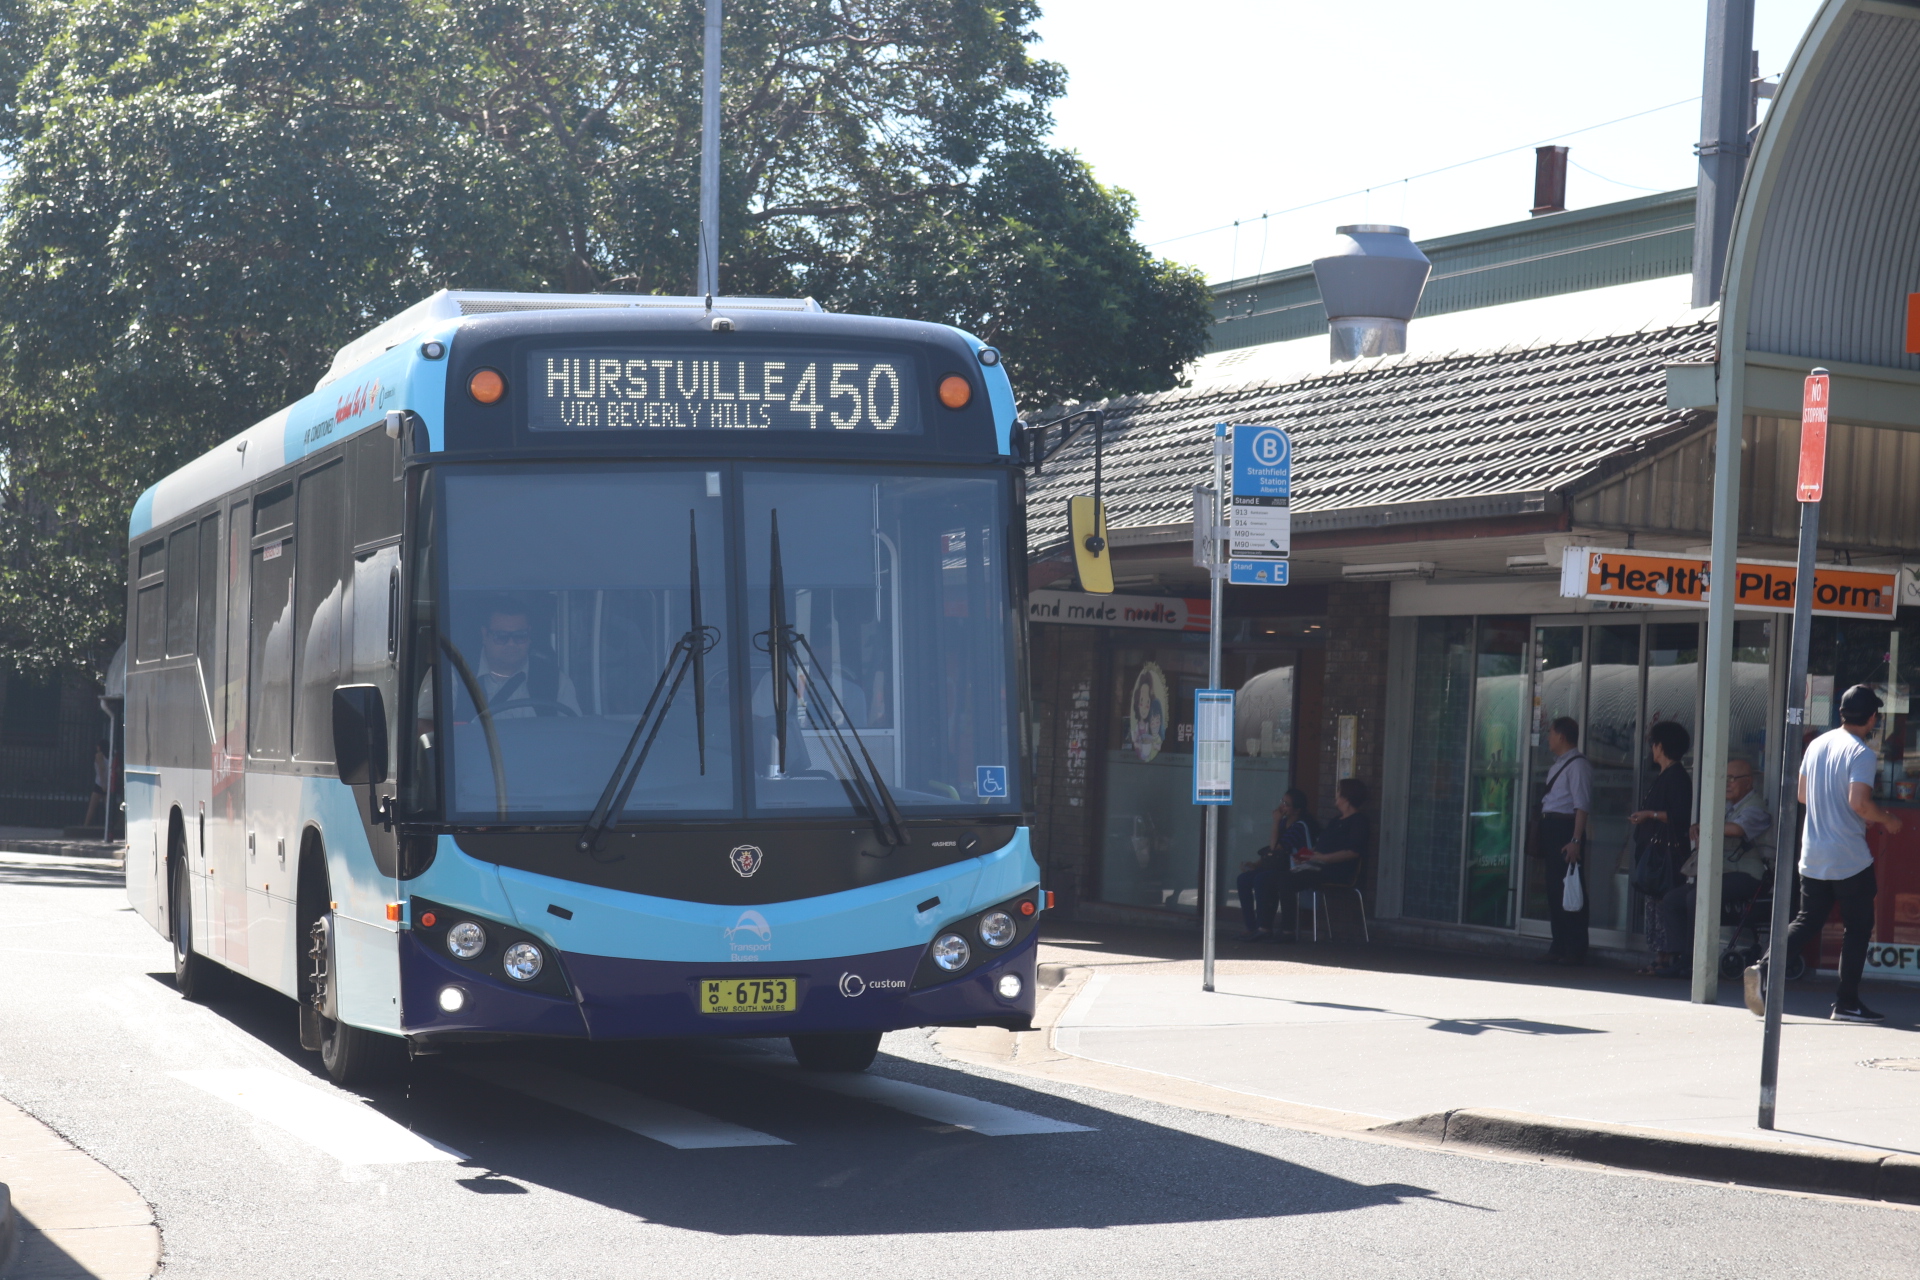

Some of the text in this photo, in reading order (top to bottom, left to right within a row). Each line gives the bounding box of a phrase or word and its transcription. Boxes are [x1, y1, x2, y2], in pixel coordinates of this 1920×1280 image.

[547, 358, 786, 401] HURSTVILLE
[790, 362, 899, 430] 450
[1811, 383, 1822, 402] NO
[560, 401, 771, 429] VIA BEVERLY HILLS
[1803, 407, 1827, 423] STOPPING
[1263, 438, 1278, 459] B
[1247, 467, 1287, 476] Strathfield
[1260, 477, 1287, 486] Station
[1235, 497, 1260, 505] Stand E
[1235, 508, 1248, 516] 913
[1234, 519, 1248, 527] 914
[1274, 564, 1284, 582] E
[1739, 571, 1882, 607] Plaorm
[1067, 601, 1117, 621] made
[1124, 602, 1177, 624] noodle
[729, 942, 771, 952] Transport
[731, 953, 759, 962] Buses
[1867, 946, 1920, 969] COF
[736, 981, 787, 1005] 6753
[869, 980, 906, 989] custom
